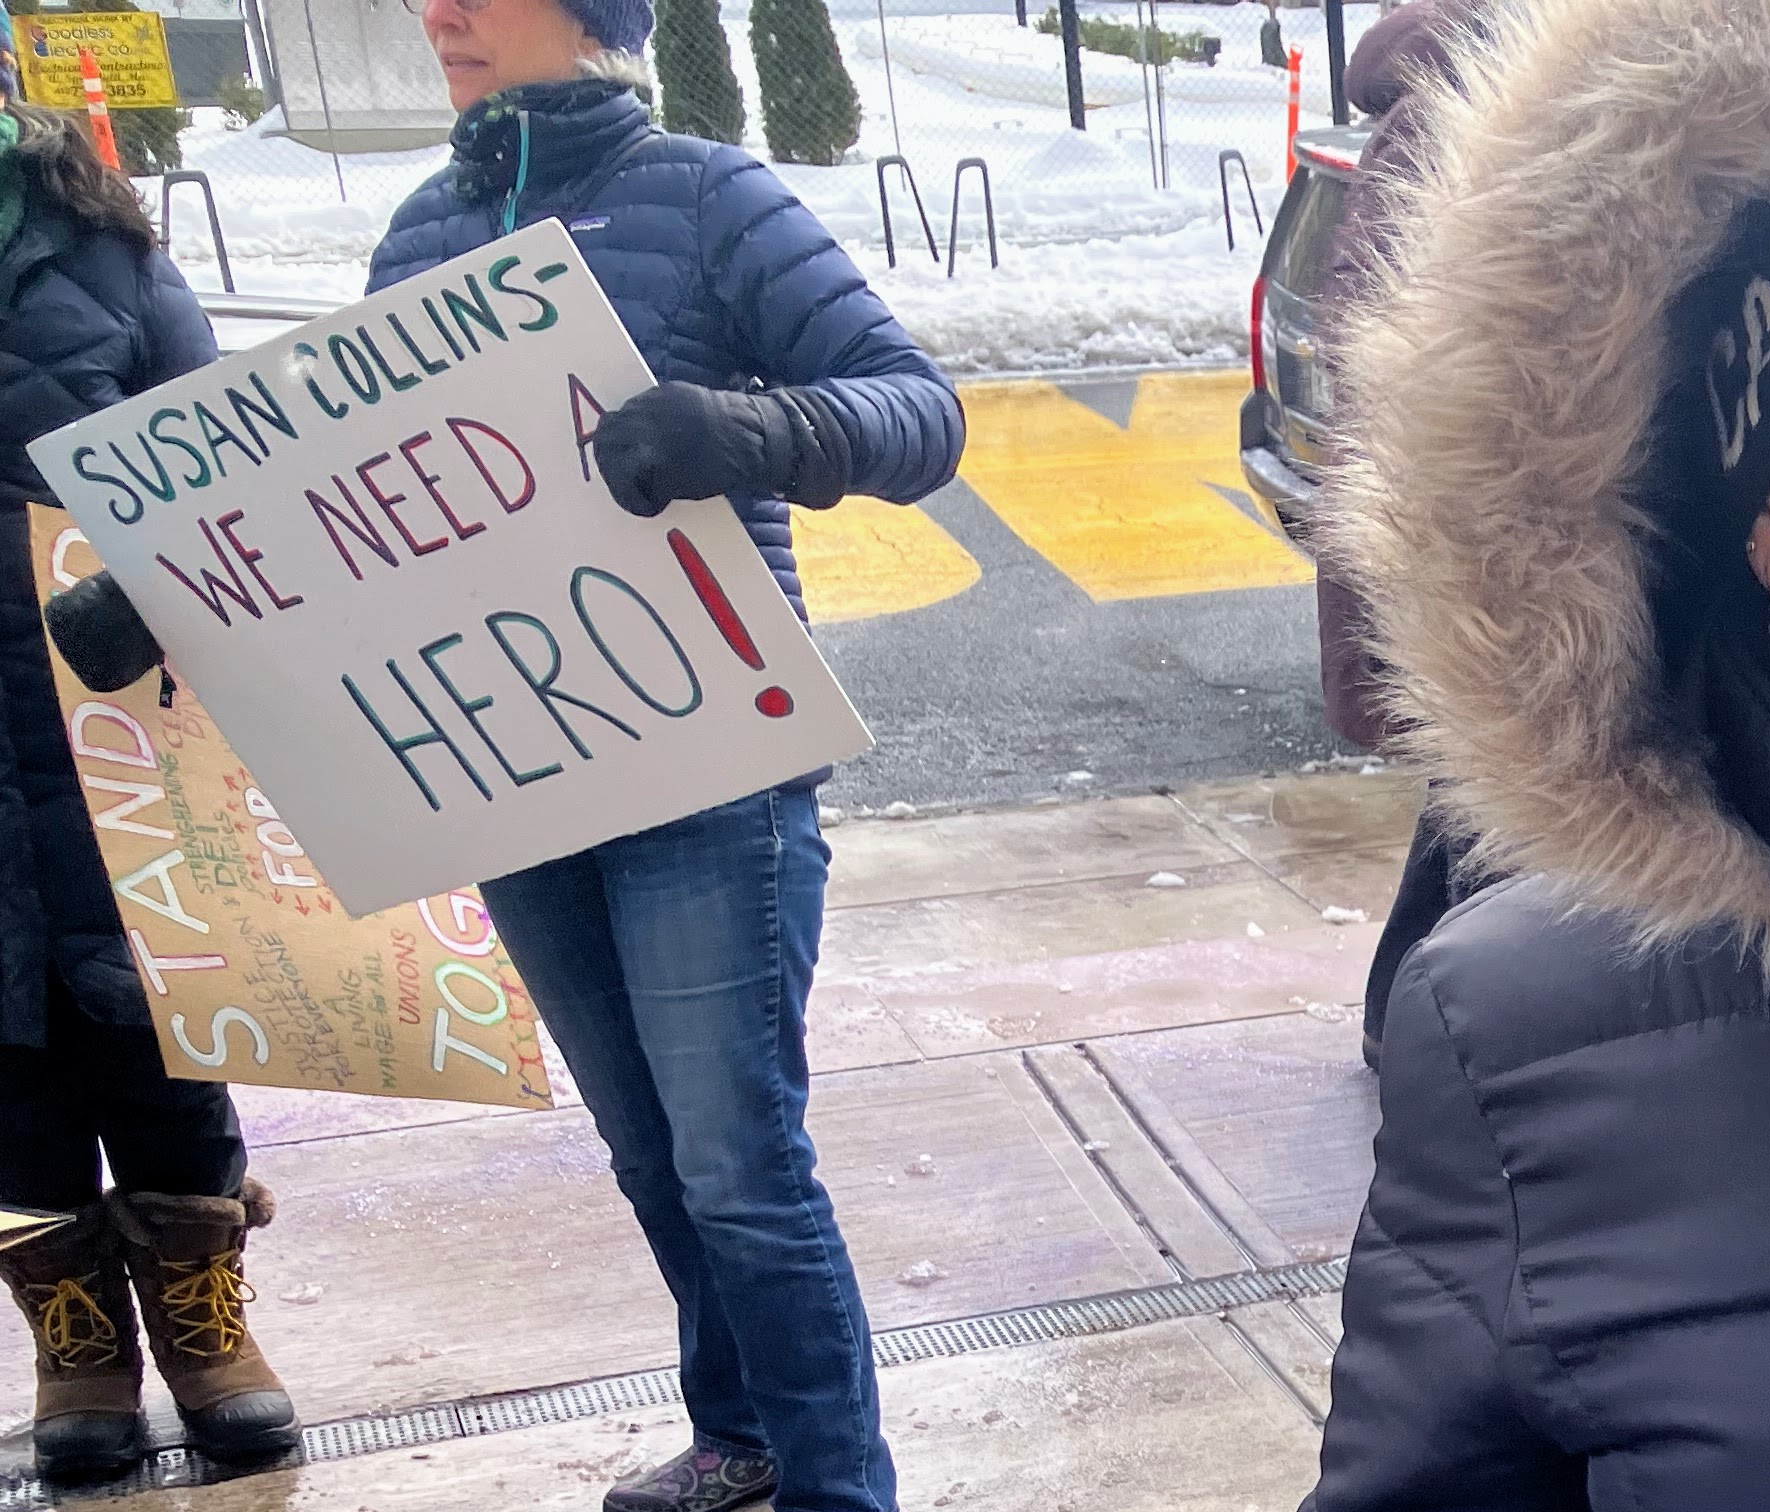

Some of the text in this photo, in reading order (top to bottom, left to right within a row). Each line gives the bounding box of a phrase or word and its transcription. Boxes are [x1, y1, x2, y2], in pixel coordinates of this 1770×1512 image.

[72, 254, 569, 526] SUSAN COLLINS-
[156, 507, 304, 629] WE
[304, 416, 537, 583] NEED
[68, 700, 270, 1070] STAND
[391, 929, 420, 1024] UNIONS
